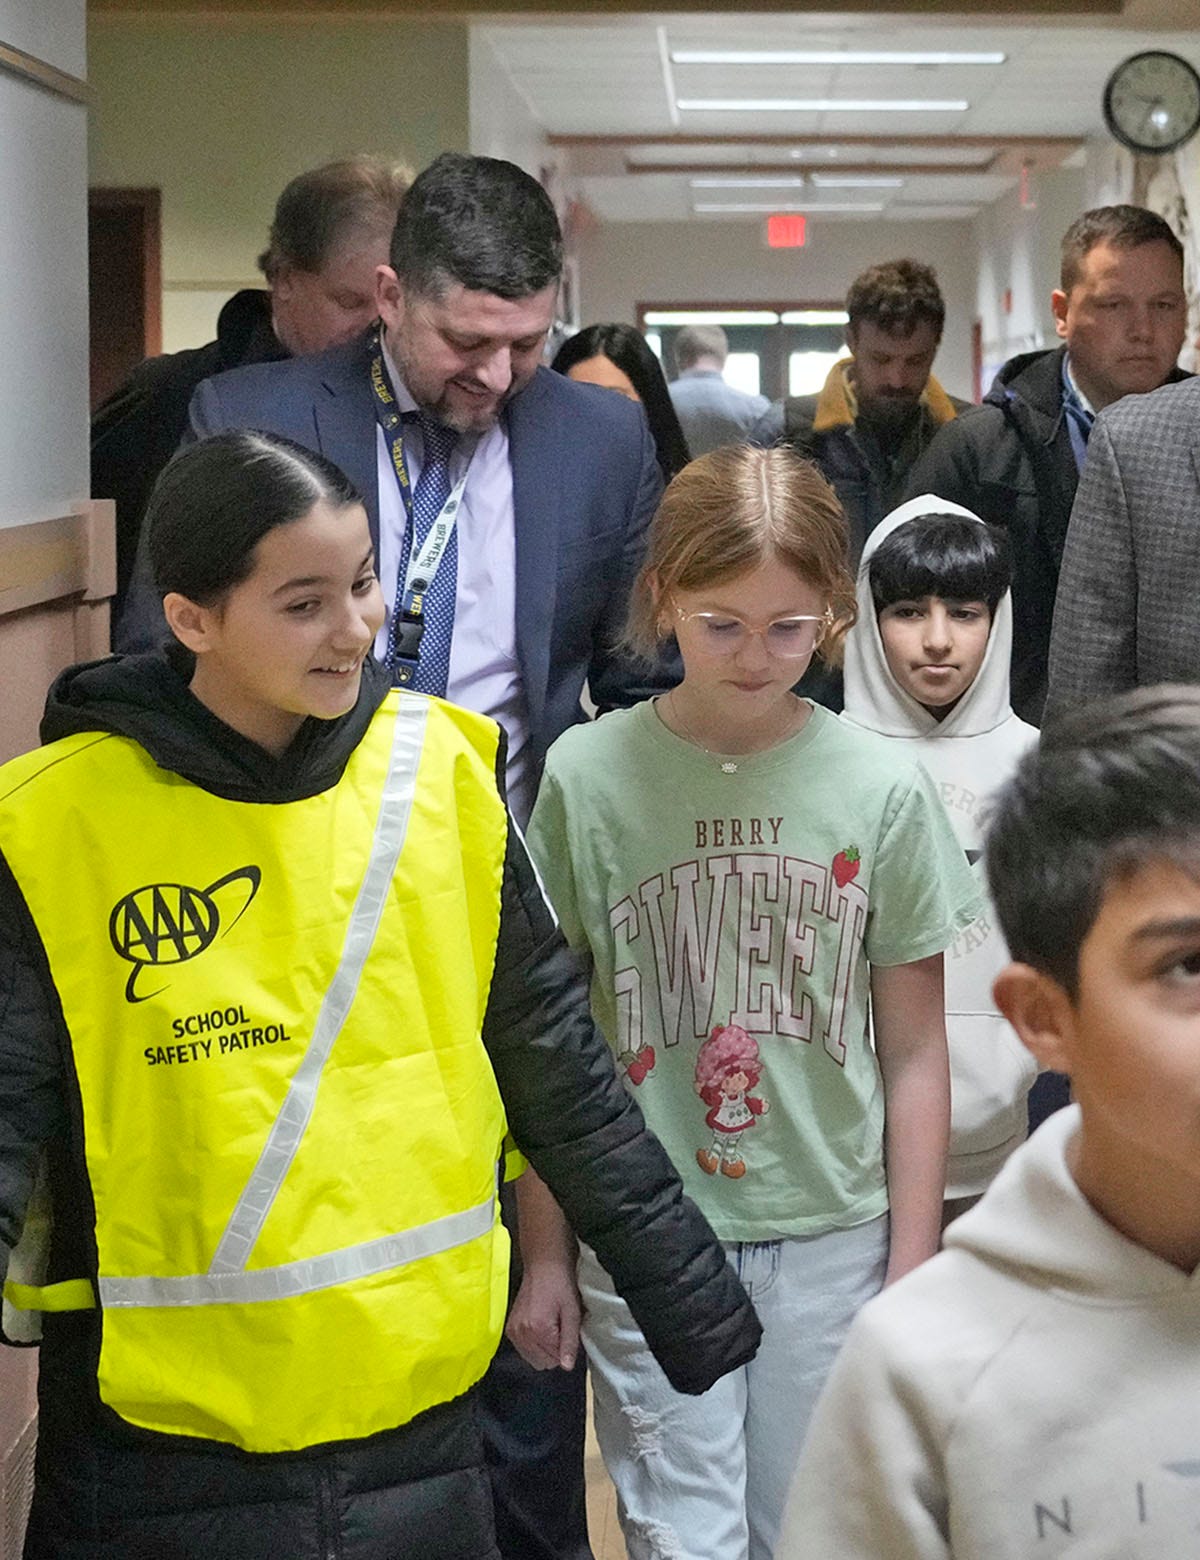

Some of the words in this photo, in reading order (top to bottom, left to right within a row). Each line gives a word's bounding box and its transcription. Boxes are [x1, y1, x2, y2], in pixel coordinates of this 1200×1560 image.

[418, 523, 447, 569] BREWERS
[695, 817, 784, 848] BERRY
[115, 884, 212, 963] AAA
[608, 853, 869, 1067] SWEET
[171, 1005, 251, 1039] SCHOOL
[143, 1039, 213, 1066] SAFETY
[218, 1023, 291, 1054] PATROL
